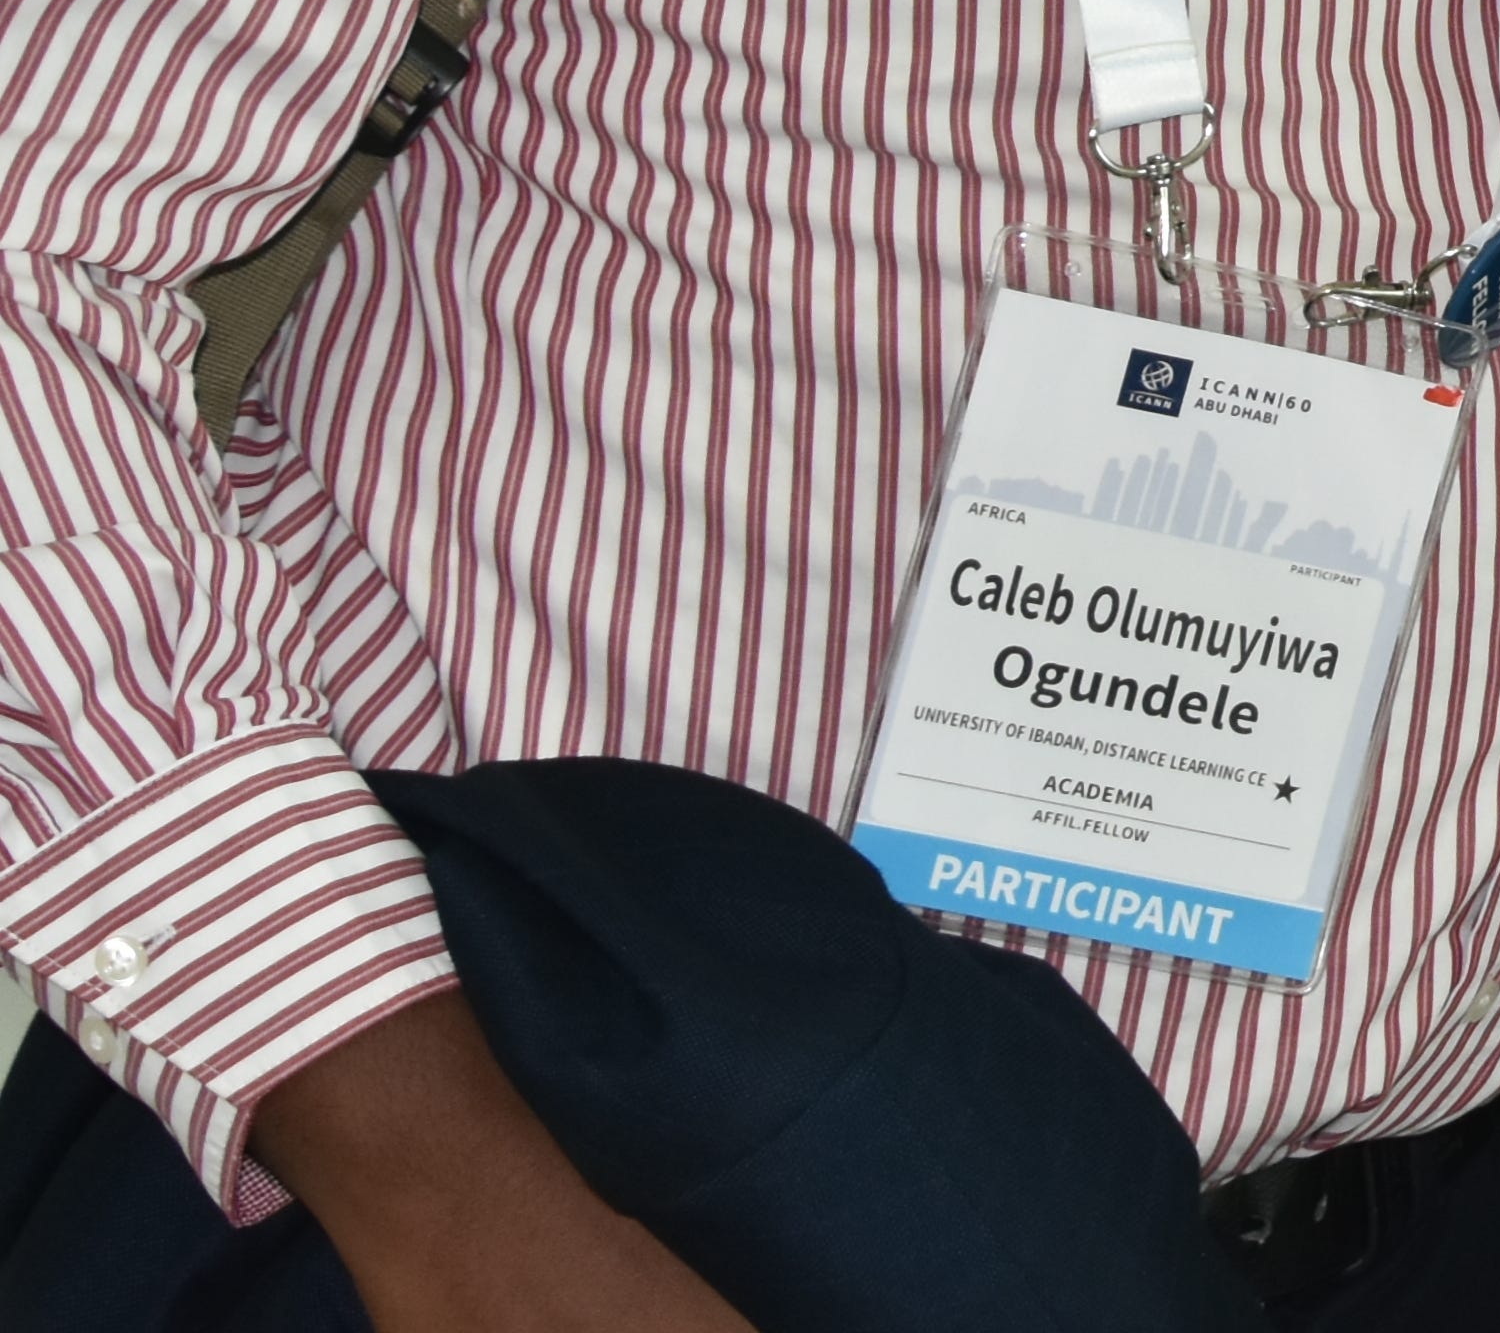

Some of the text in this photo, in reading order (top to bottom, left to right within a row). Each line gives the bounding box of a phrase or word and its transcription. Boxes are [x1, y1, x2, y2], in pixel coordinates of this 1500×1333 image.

[1129, 393, 1173, 410] ICANN
[1194, 397, 1279, 426] ABU DHABI
[967, 501, 1027, 526] AFRICA
[1290, 564, 1362, 588] PARTICIPANT
[950, 558, 1339, 680] Caleb Olumuyiwa
[992, 645, 1260, 735] Ogundele
[913, 705, 1267, 787] UNIVERSITY OF IBADAN, DISTANCE LEARNING CE
[1042, 775, 1155, 812] ACADEMIA
[1032, 808, 1150, 843] AFFIL.FELLOW
[928, 853, 1233, 945] PARTICIPANT
